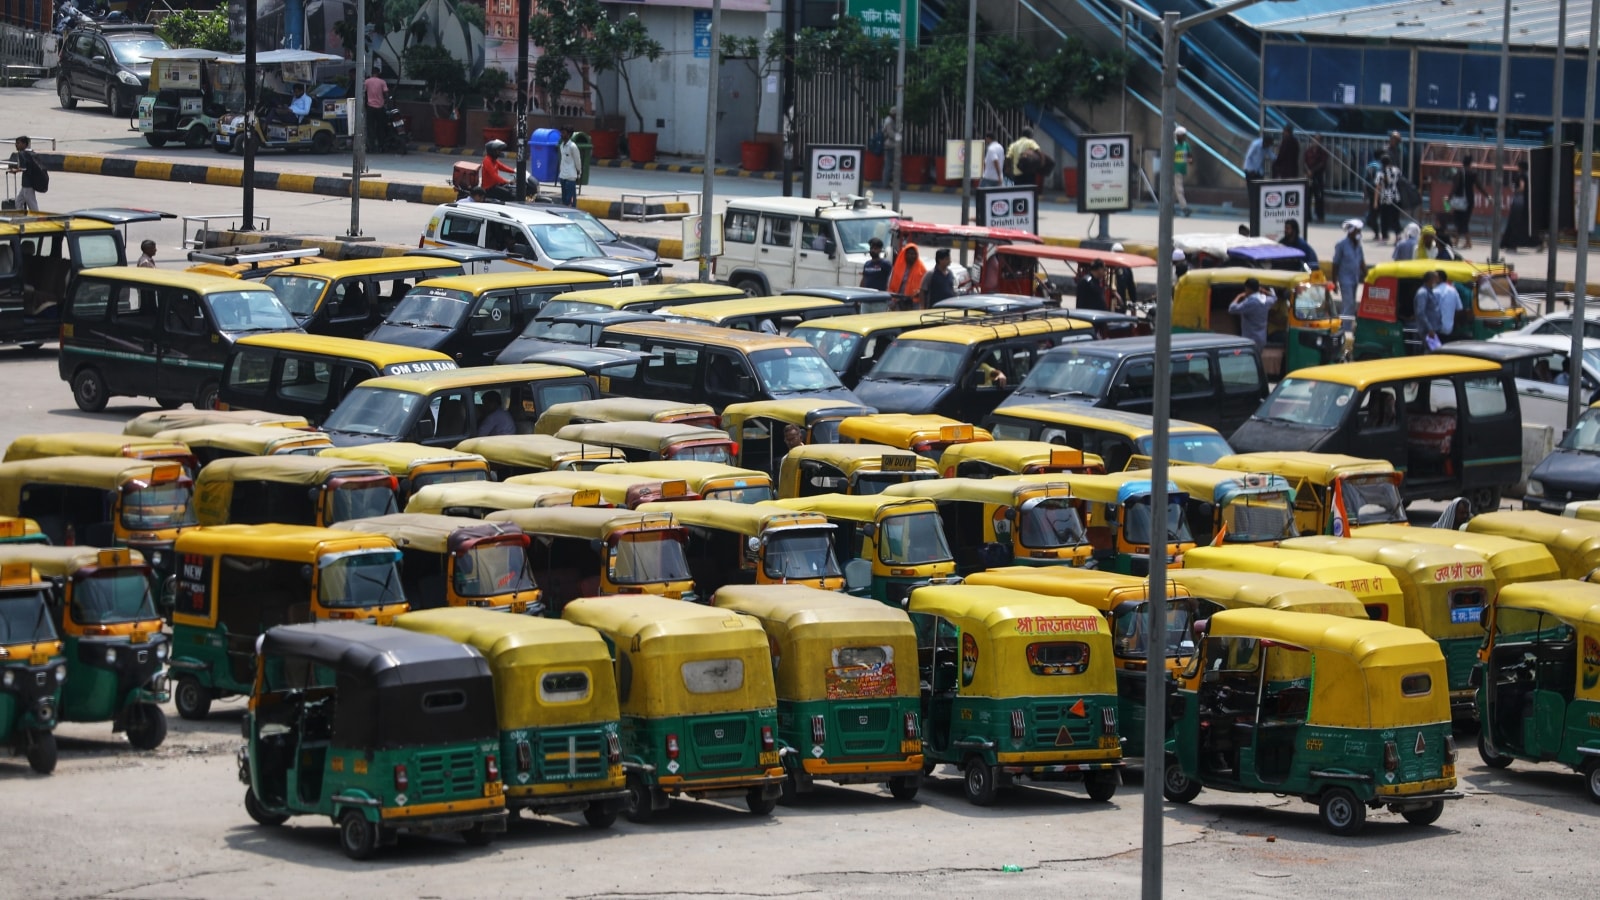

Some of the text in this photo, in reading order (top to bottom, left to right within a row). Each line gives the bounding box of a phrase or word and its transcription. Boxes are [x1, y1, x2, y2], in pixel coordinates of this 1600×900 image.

[1090, 160, 1125, 169] Drishti IAS
[816, 172, 841, 180] Drishti
[1264, 209, 1300, 218] Drishti IAS
[990, 216, 1030, 227] Drishti IAS
[390, 362, 457, 376] OM SAI RAM
[884, 456, 913, 467] ON DUTY
[183, 564, 203, 580] NEW
[1450, 562, 1463, 579] श्री
[1465, 563, 1483, 579] राम
[1017, 616, 1033, 632] श्री
